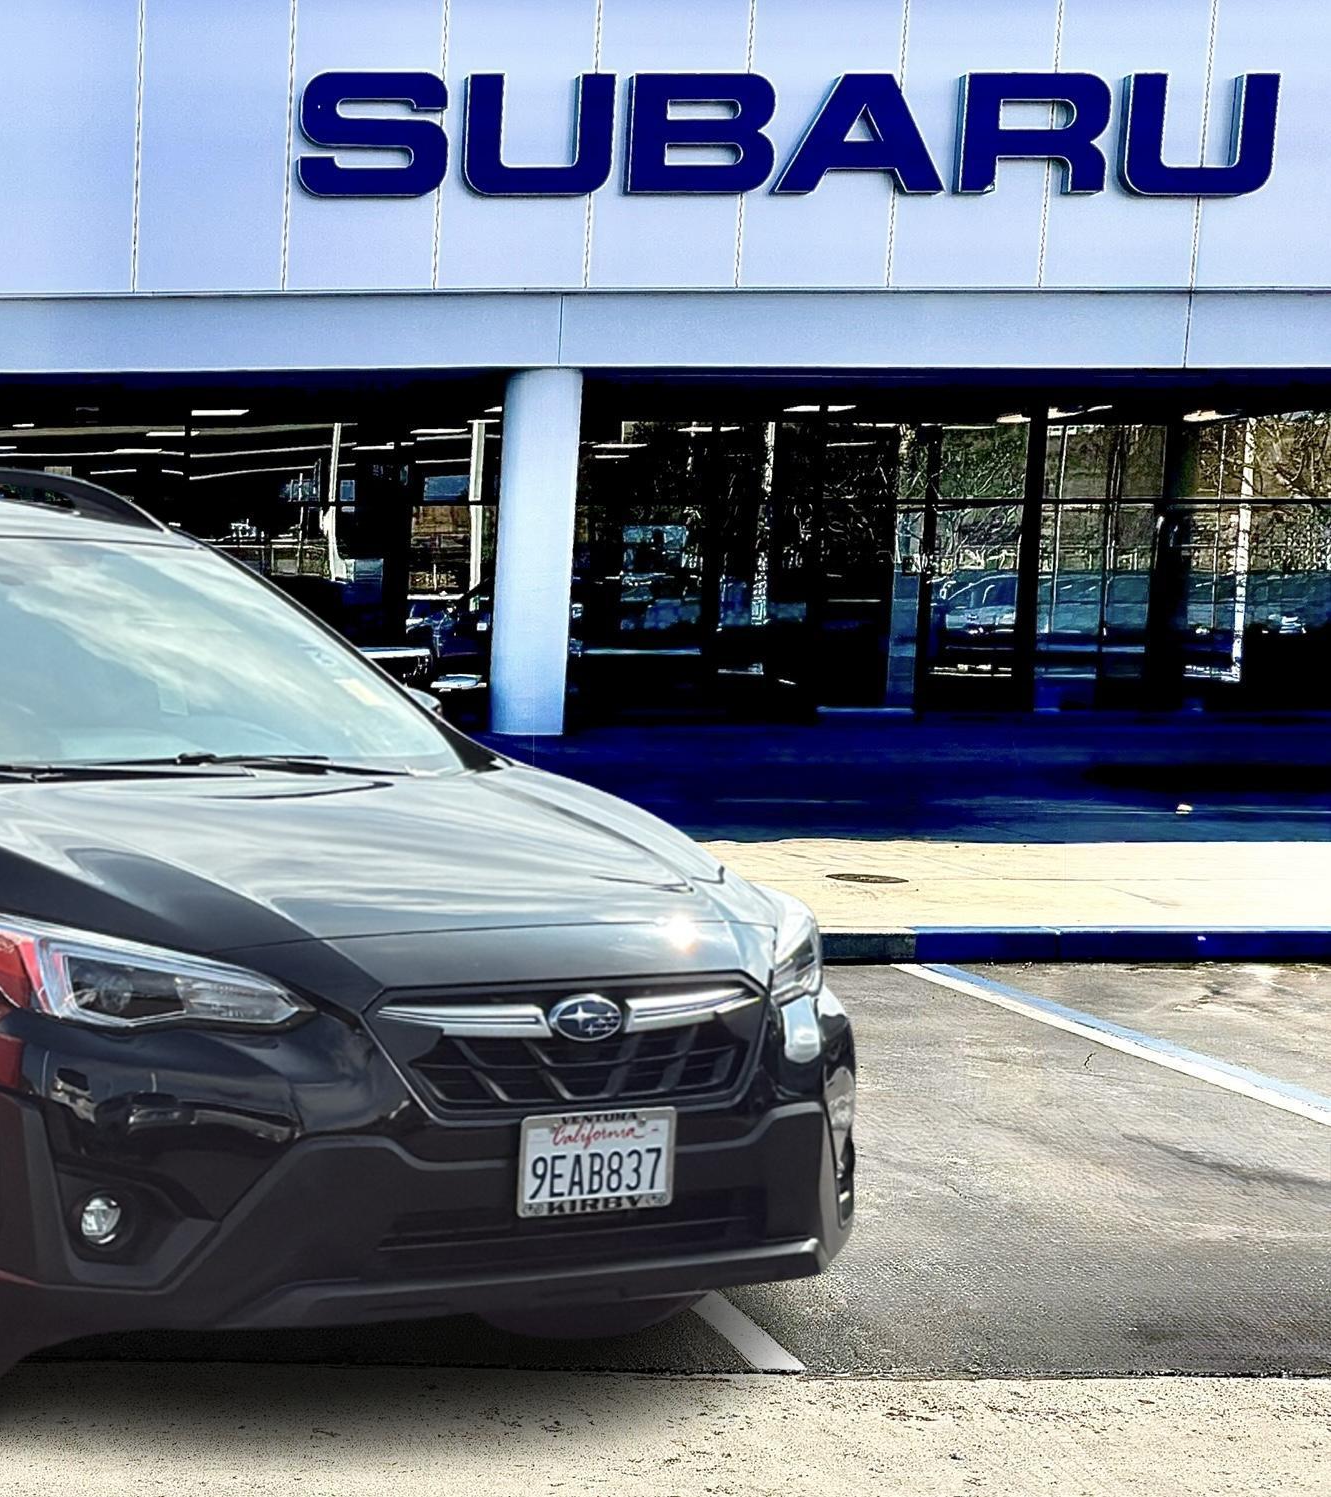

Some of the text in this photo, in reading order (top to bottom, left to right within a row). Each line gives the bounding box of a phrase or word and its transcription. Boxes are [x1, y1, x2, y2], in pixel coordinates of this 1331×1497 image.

[298, 71, 1280, 198] SUBARU
[561, 1111, 638, 1125] VENTURA
[552, 1122, 644, 1149] California
[529, 1148, 662, 1200] 9EAB837
[547, 1195, 642, 1214] KIRBY
